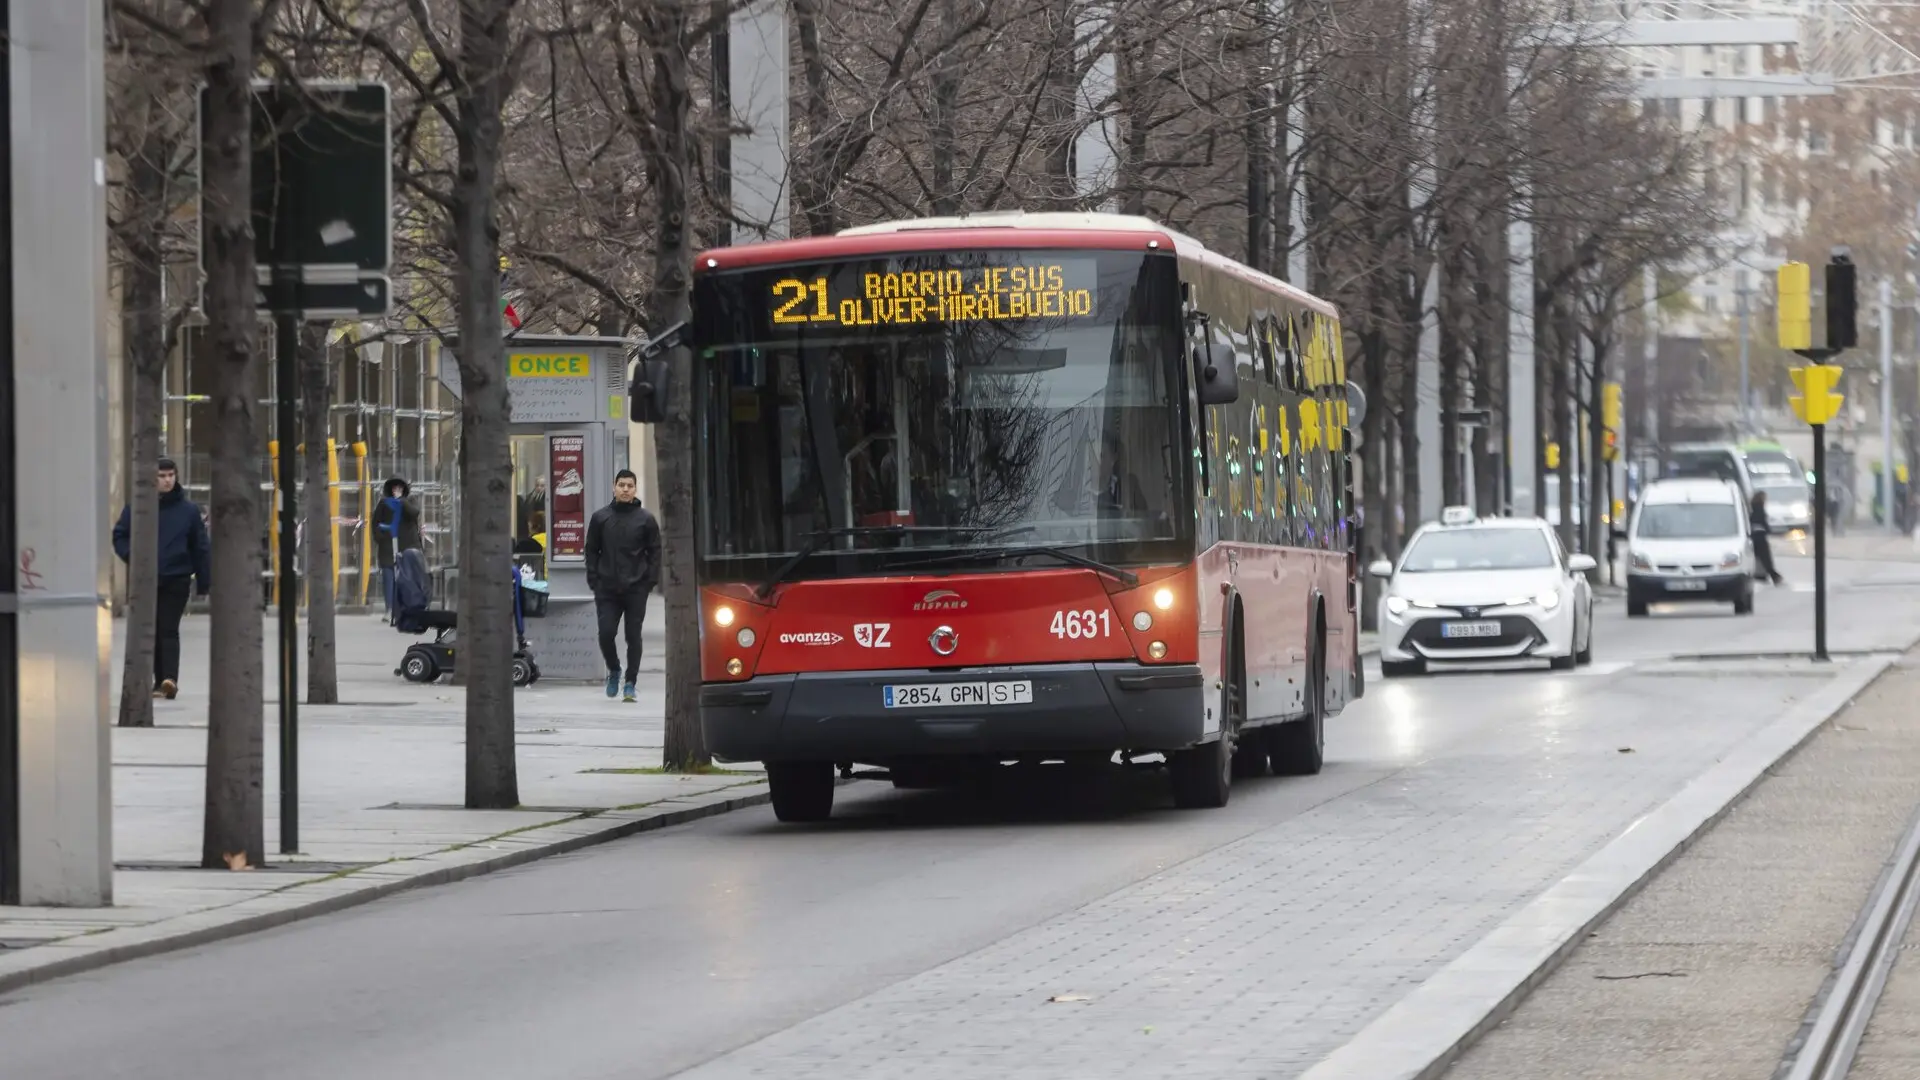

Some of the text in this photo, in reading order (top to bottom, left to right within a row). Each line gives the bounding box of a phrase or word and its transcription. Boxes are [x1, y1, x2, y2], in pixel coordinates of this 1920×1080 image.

[865, 265, 1064, 299] BARRIO JESUS
[773, 277, 836, 323] 21
[839, 289, 1091, 326] OLIVER-MIRALBUENO
[518, 356, 581, 373] ONCE
[913, 600, 968, 610] HISPANO
[874, 623, 891, 648] Z
[1050, 609, 1110, 639] 4631
[780, 632, 830, 643] avanza
[898, 685, 984, 705] 2854 GPN
